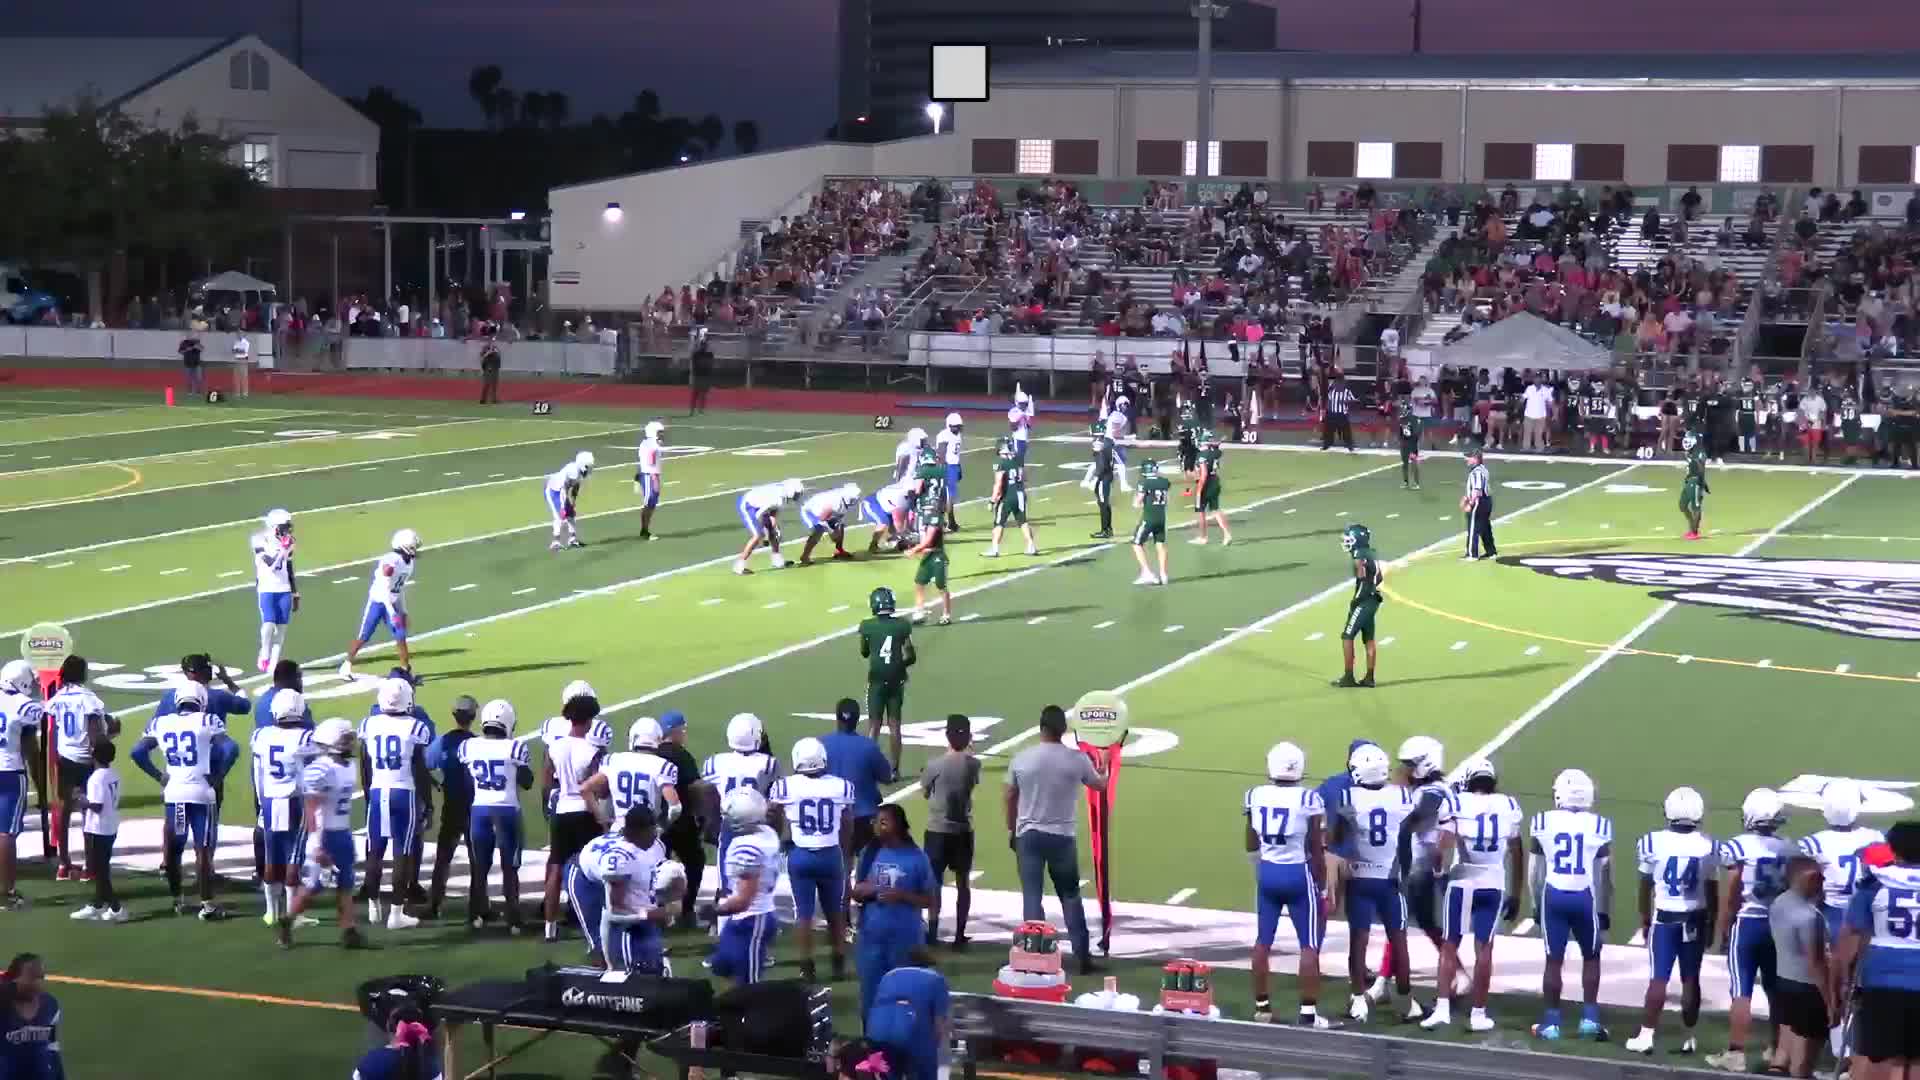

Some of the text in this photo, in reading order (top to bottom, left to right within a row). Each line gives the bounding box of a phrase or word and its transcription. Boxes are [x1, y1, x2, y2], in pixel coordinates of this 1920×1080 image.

[534, 403, 549, 413] 10
[875, 416, 889, 428] 20
[1241, 431, 1258, 443] 30
[1636, 446, 1654, 459] 40
[29, 639, 64, 649] SPORTS
[879, 635, 893, 665] 4
[63, 711, 75, 737] 0
[1081, 710, 1116, 720] SPORTS
[163, 731, 198, 766] 23
[270, 745, 284, 779] 5
[374, 735, 402, 770] 18
[473, 760, 506, 791] 25
[616, 771, 651, 808] 95
[799, 798, 834, 835] 60
[1259, 805, 1290, 845] 17
[1369, 807, 1388, 847] 8
[1473, 813, 1499, 852] 11
[1553, 832, 1586, 875] 21
[1663, 855, 1699, 897] 44
[1838, 855, 1857, 895] 7
[1888, 888, 1920, 940] 5
